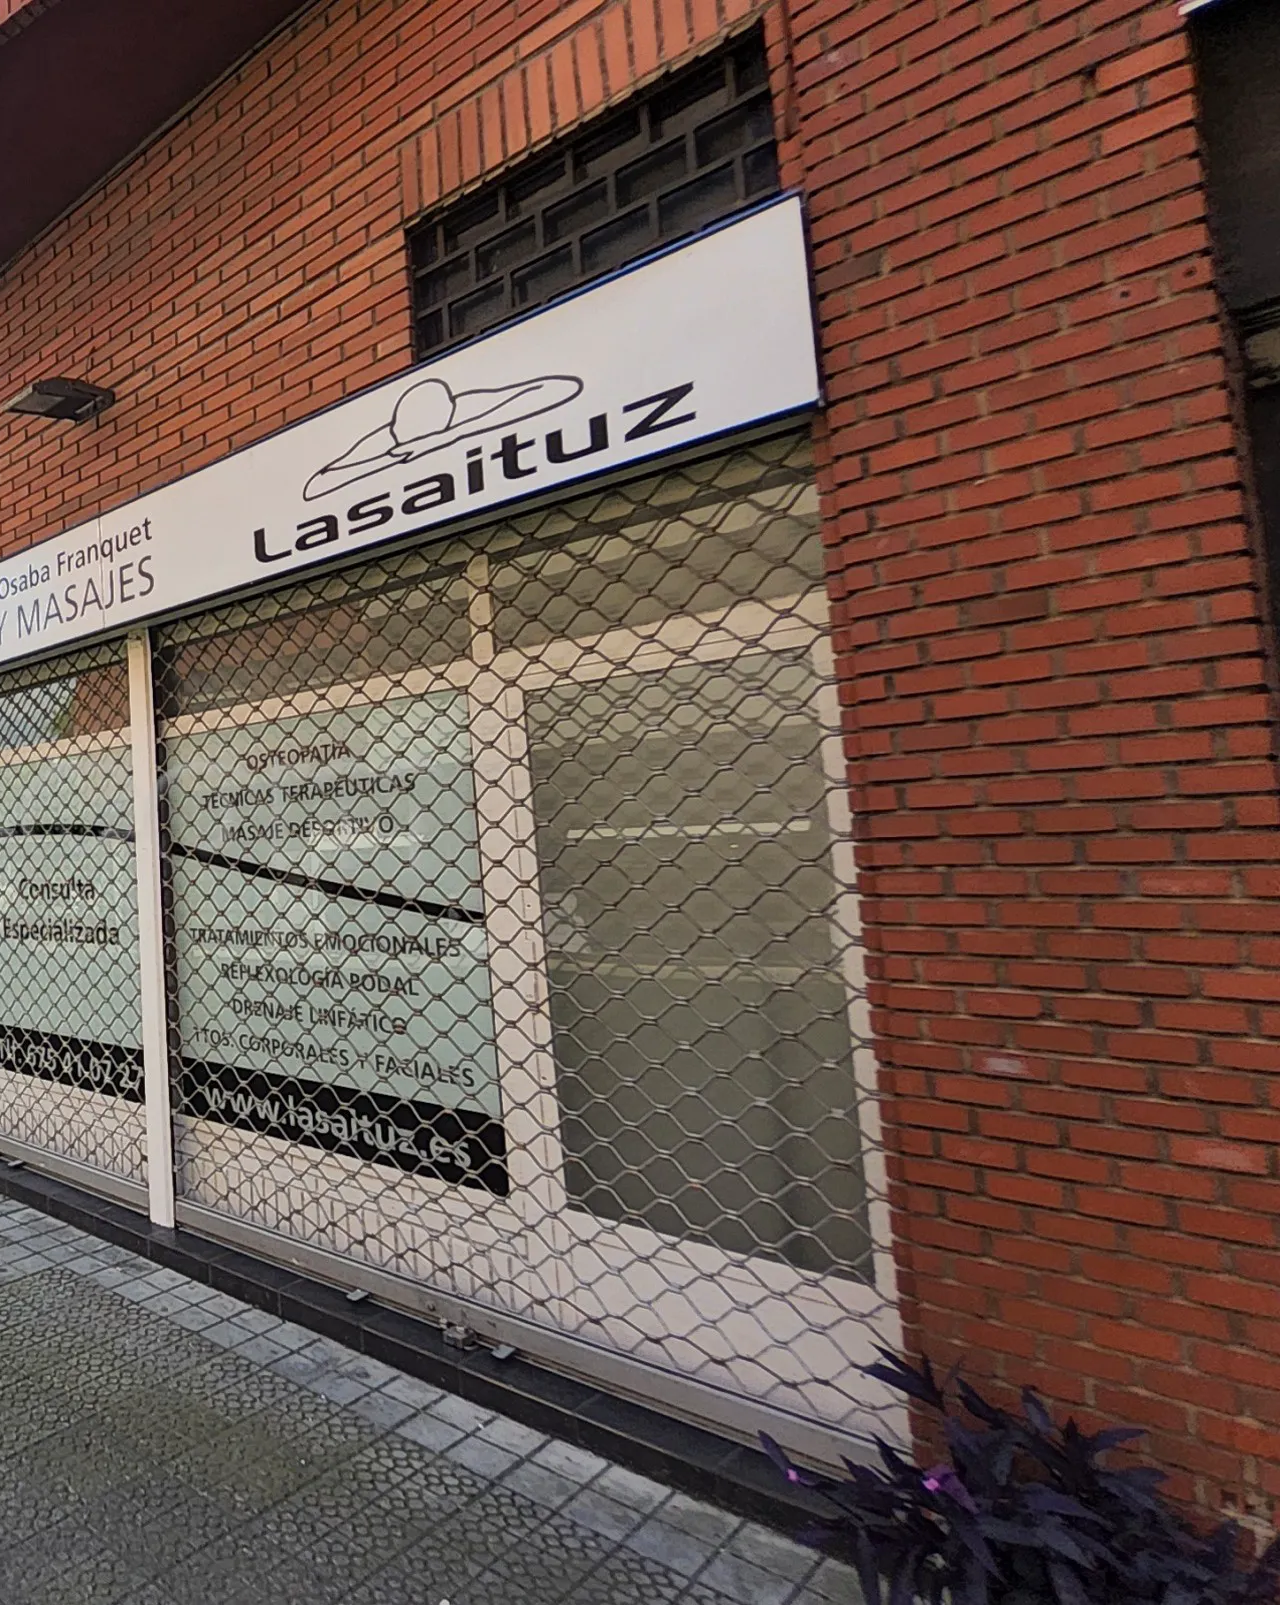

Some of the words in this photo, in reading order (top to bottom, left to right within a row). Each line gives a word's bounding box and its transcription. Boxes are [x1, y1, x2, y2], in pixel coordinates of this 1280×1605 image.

[253, 380, 697, 564] Lasaituz
[56, 517, 153, 577] Franquet
[16, 555, 156, 639] MASAJES
[19, 875, 96, 901] Consulta
[3, 917, 120, 946] Especializada
[190, 927, 307, 950] TRATAMIENTOS
[314, 931, 461, 958] EMOCIONALES
[350, 974, 420, 996] PODAL
[232, 998, 303, 1022] DRENAJE
[238, 1033, 350, 1066] CORPORALES
[375, 1055, 475, 1087] FACIALES
